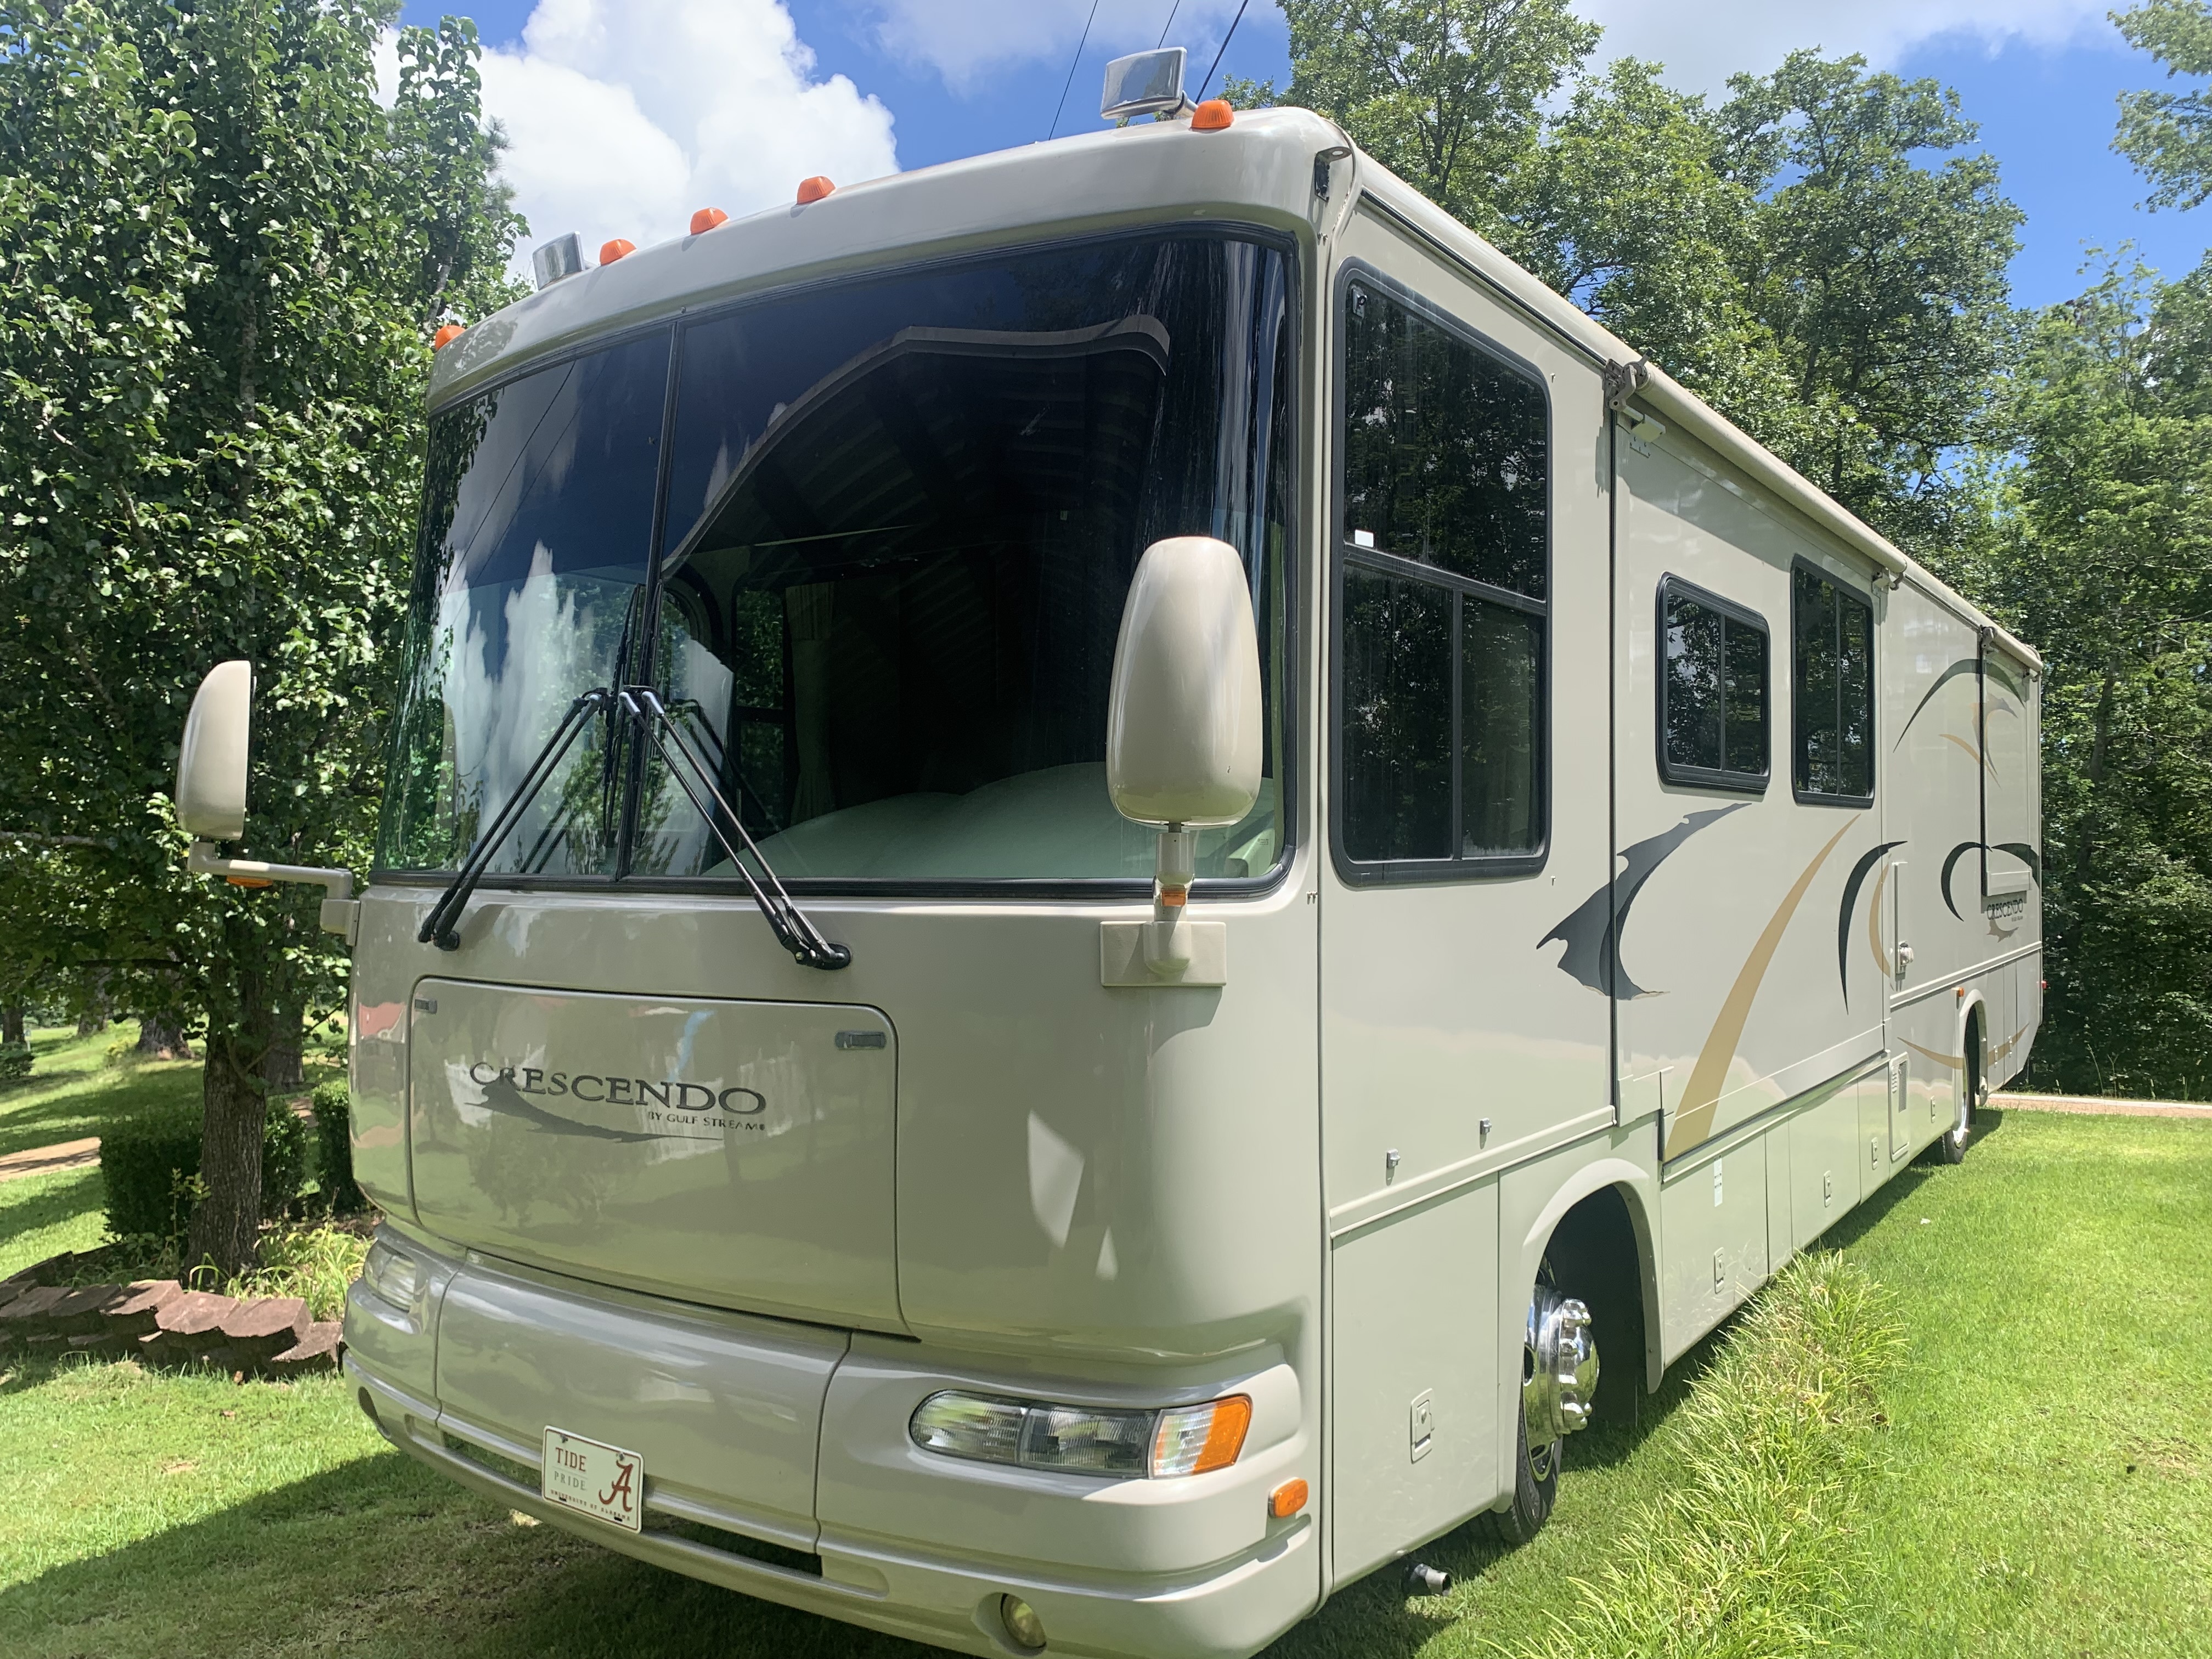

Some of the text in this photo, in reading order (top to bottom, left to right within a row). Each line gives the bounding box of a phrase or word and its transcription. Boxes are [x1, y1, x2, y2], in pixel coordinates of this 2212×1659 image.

[1987, 898, 2023, 921] CRESCENDO
[470, 1061, 766, 1115] CRESCENDO
[648, 1110, 662, 1120] BY
[667, 1113, 698, 1124] GULF
[555, 1447, 587, 1472] TIDE
[554, 1470, 587, 1491] PRIDE
[599, 1459, 633, 1512] A
